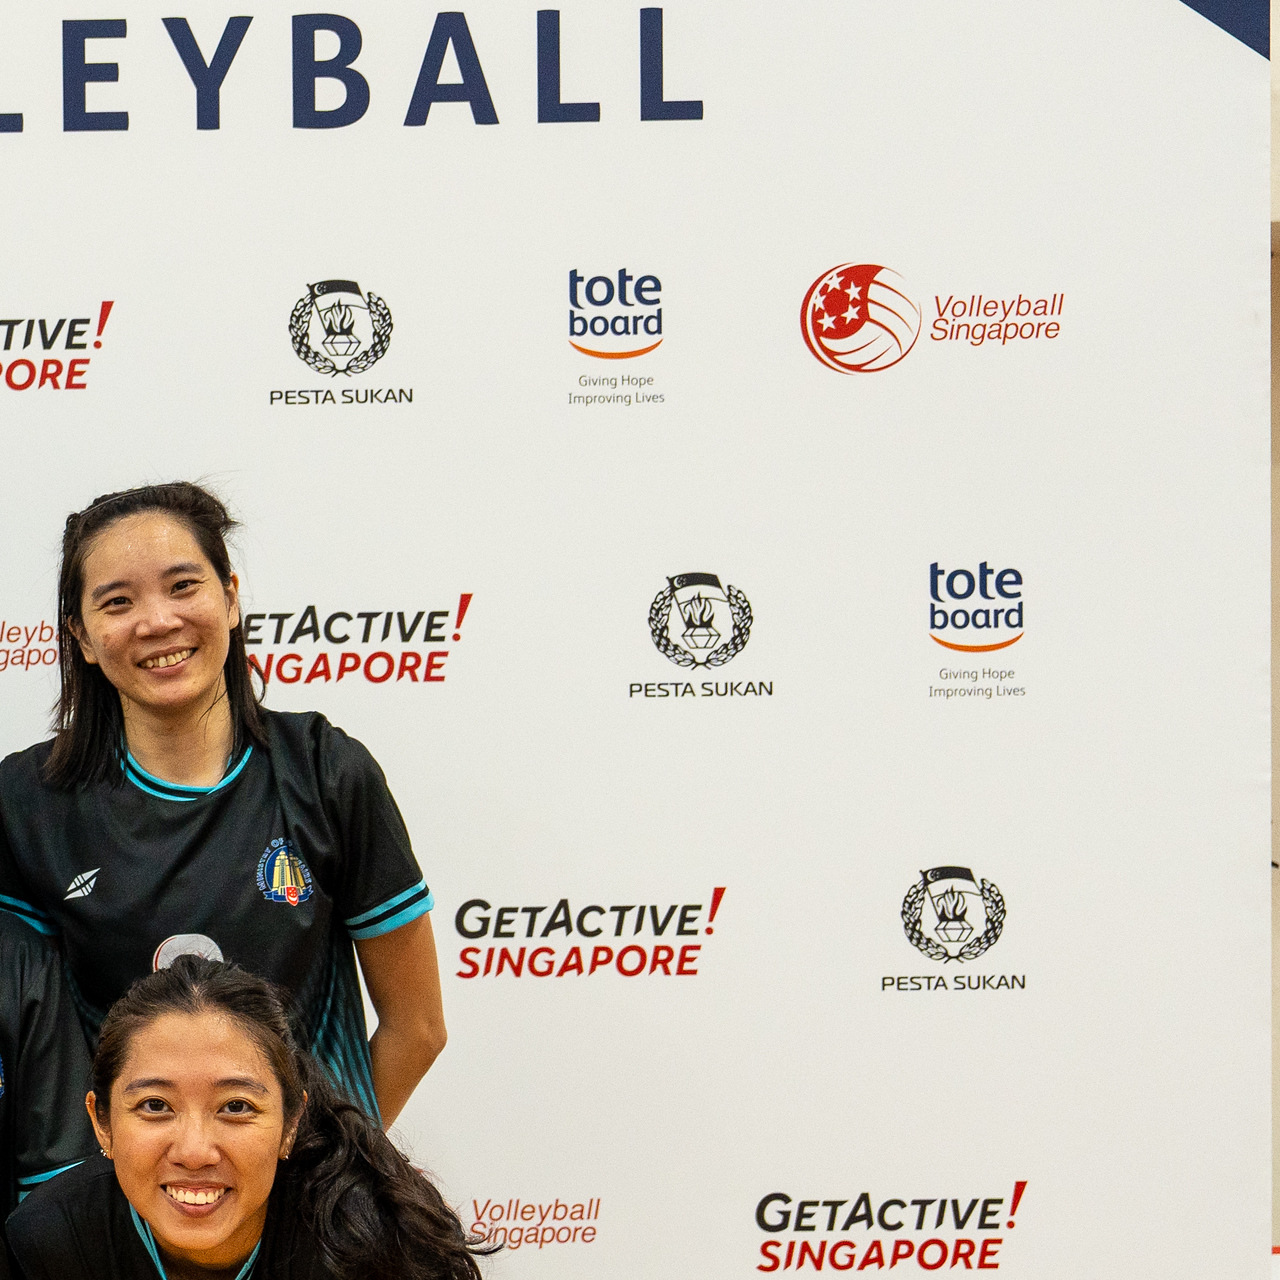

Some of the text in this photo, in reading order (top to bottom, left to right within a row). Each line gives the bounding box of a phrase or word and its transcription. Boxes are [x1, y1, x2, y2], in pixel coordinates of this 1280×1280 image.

[569, 268, 662, 310] tote
[934, 293, 1064, 320] Volleyball
[569, 308, 662, 336] board
[930, 317, 1060, 346] Singapore
[579, 375, 654, 389] Giving Hope
[270, 389, 413, 405] PESTA SUKAN
[569, 392, 664, 406] Improving Lives
[930, 561, 1023, 603] tote
[930, 601, 1023, 630] board
[247, 651, 449, 684] NGAPORE
[939, 668, 1015, 682] Giving Hope
[630, 681, 773, 697] PESTA SUKAN
[930, 686, 1026, 699] Improving Lives
[456, 944, 702, 979] SINGAPORE
[882, 975, 1025, 991] PESTA SUKAN
[473, 1198, 601, 1226] Volleyball
[470, 1221, 596, 1250] Singapore
[756, 1238, 1003, 1272] SINGAPORE
